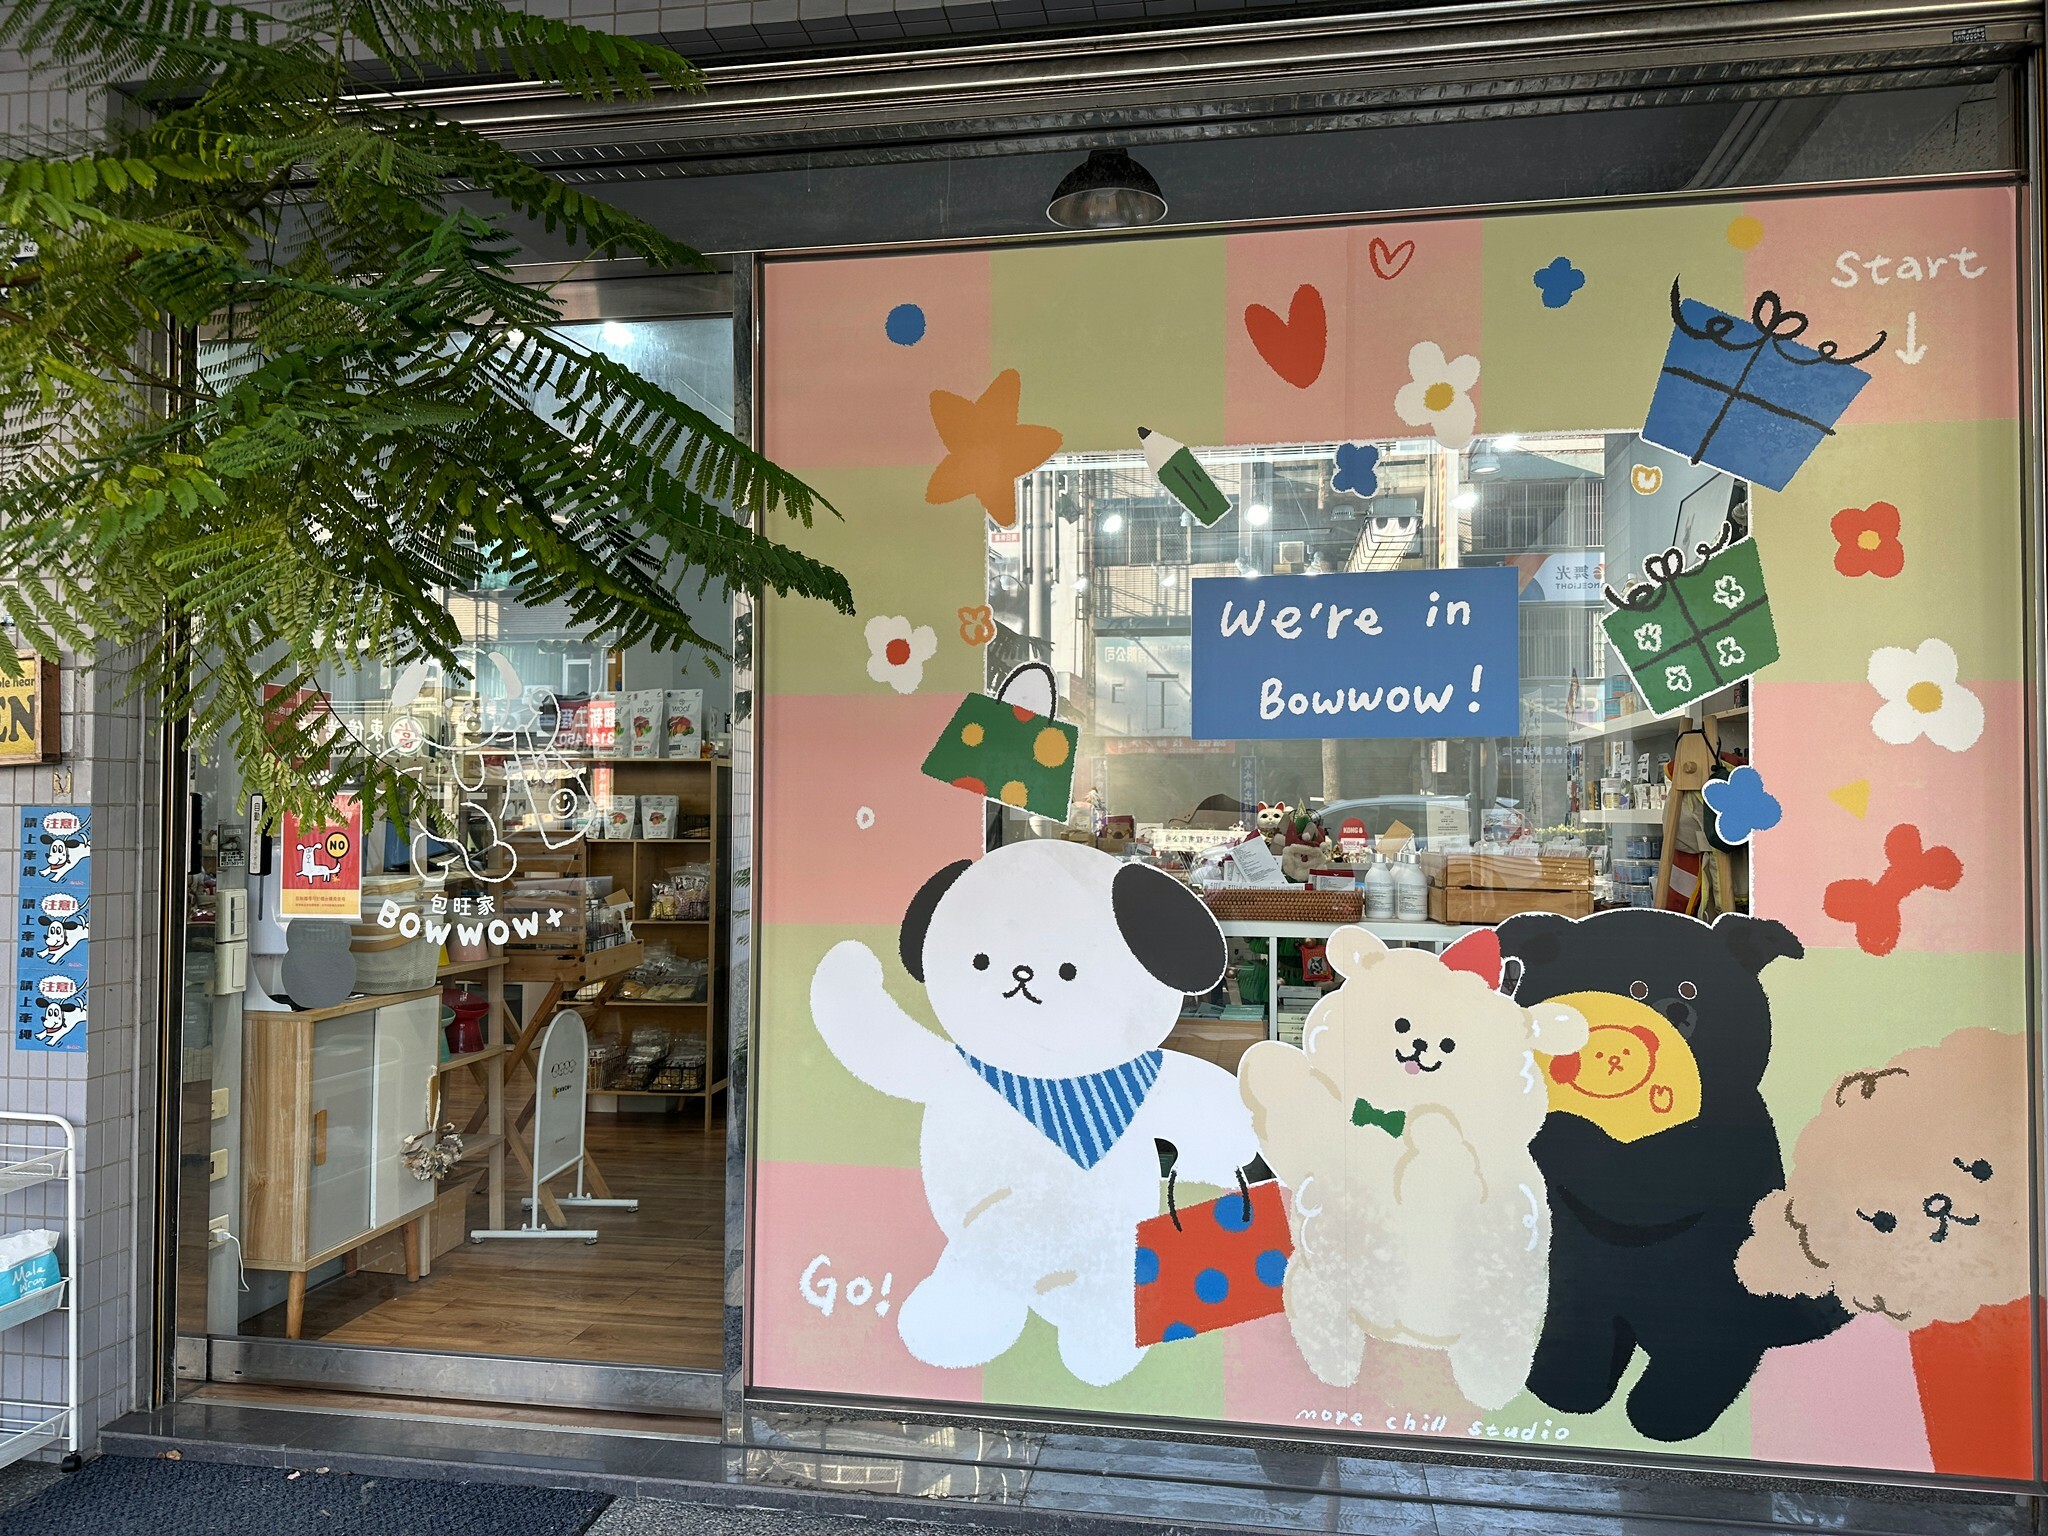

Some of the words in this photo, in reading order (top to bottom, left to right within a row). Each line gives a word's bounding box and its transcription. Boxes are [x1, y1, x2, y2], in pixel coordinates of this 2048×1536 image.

[1830, 247, 1988, 289] Start
[1220, 598, 1384, 641] We're
[1426, 591, 1472, 629] in
[46, 818, 77, 829] 注意!
[1343, 826, 1358, 834] KONG
[23, 817, 38, 877] 請上牽繩
[329, 840, 346, 851] NO
[44, 899, 76, 911] 注意!
[431, 894, 496, 916] 包旺家
[21, 898, 36, 958] 請上牽繩
[42, 981, 74, 993] 注意!
[19, 980, 33, 1040] 請上牽繩
[12, 1261, 45, 1285] Male
[799, 1253, 893, 1318] Go!
[1295, 1406, 1363, 1428] more
[1386, 1412, 1448, 1434] chill
